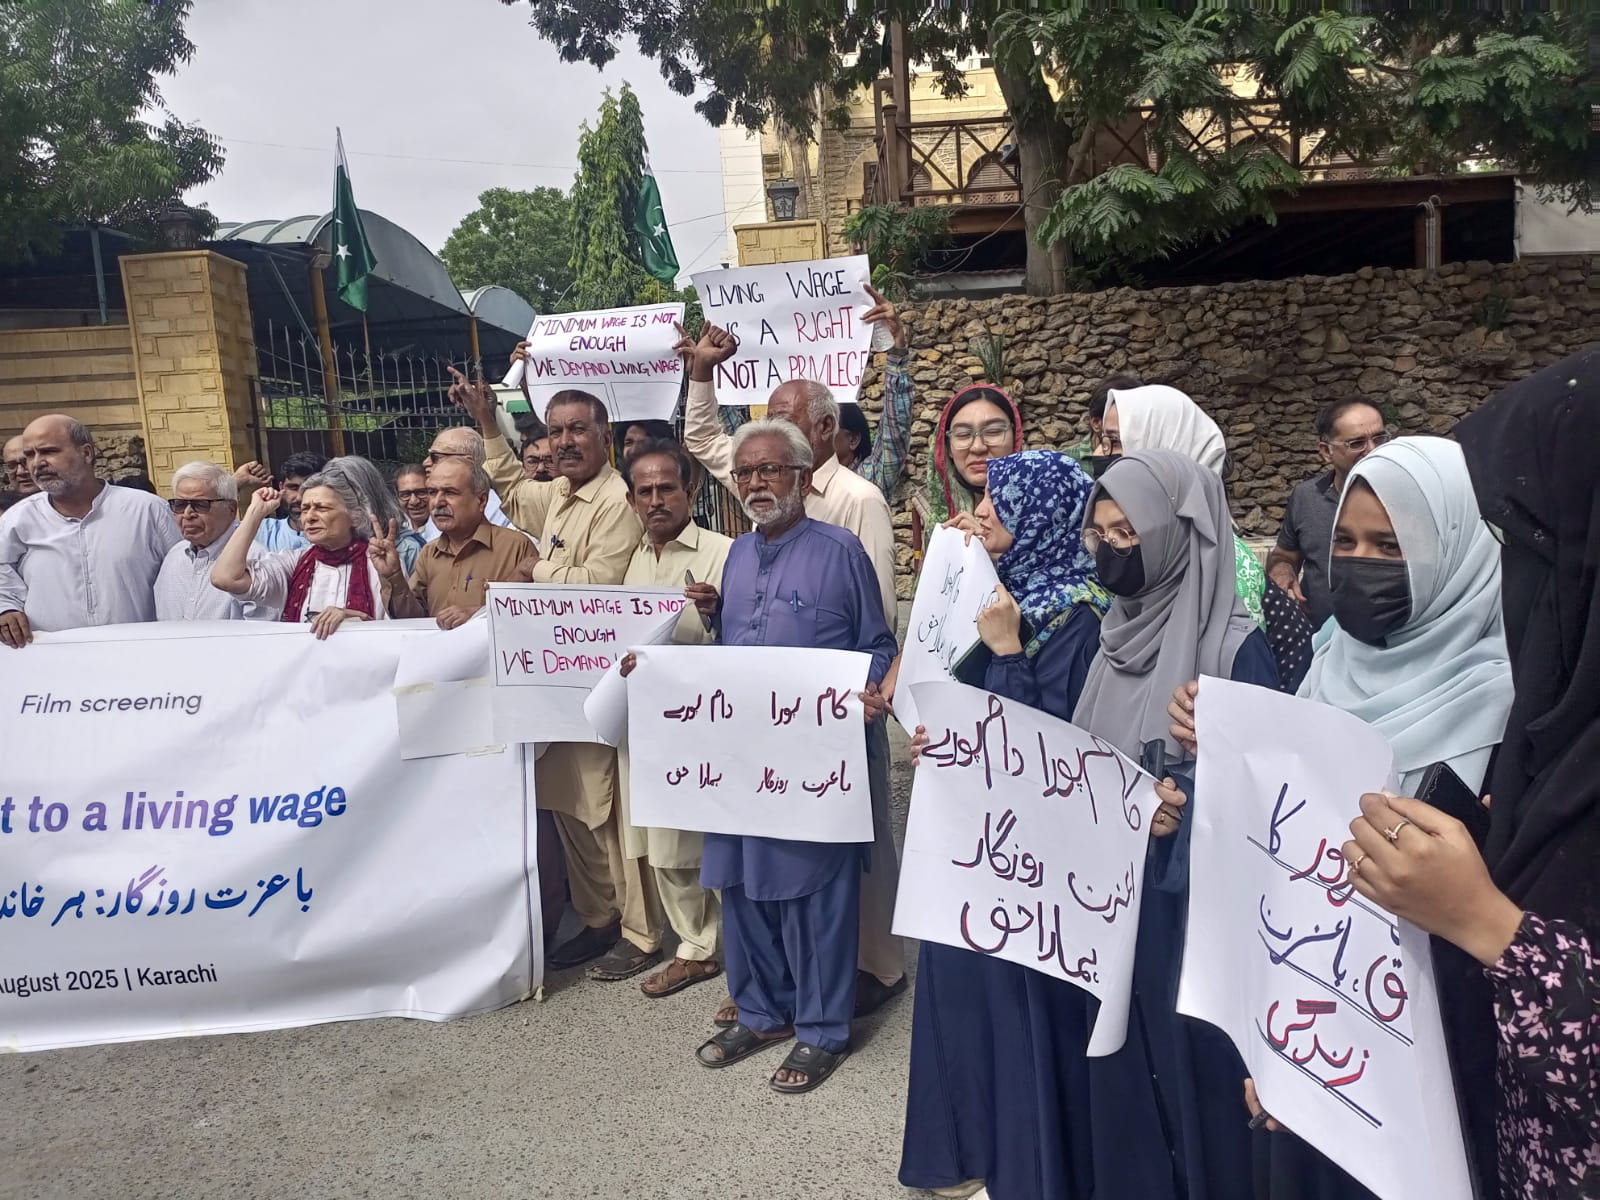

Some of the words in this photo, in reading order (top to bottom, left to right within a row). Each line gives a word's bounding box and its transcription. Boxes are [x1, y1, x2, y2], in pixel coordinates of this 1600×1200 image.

[706, 281, 765, 307] LIVING
[785, 267, 851, 299] WAGE
[532, 317, 597, 337] MINIMUM
[601, 317, 628, 329] WAGE
[631, 314, 647, 328] IS
[652, 312, 677, 325] NOT
[760, 318, 780, 345] A
[569, 335, 626, 352] ENOUGH
[532, 357, 557, 378] WE
[559, 358, 610, 378] DEMAND
[610, 360, 650, 377] LIVING
[649, 358, 680, 374] WAGE
[717, 359, 759, 389] NOT
[767, 358, 783, 389] A
[495, 597, 574, 617] MINIMUM
[580, 598, 623, 615] WAGE
[631, 598, 653, 615] IS
[658, 599, 686, 613] NOT
[554, 625, 616, 645] ENOUGH
[503, 649, 535, 675] WE
[543, 650, 611, 675] DEMAND
[20, 693, 72, 715] Film
[79, 692, 203, 715] screening
[711, 689, 733, 722] دام
[817, 687, 851, 726] کام
[922, 721, 983, 767] پورے
[28, 796, 69, 833] to
[82, 801, 107, 832] a
[121, 791, 239, 837] living
[249, 785, 347, 828] wage
[952, 808, 1044, 888] روزگار
[51, 890, 86, 927] ہر
[960, 897, 1035, 954] حق
[66, 969, 119, 991] 2025
[137, 963, 218, 987] Karachi
